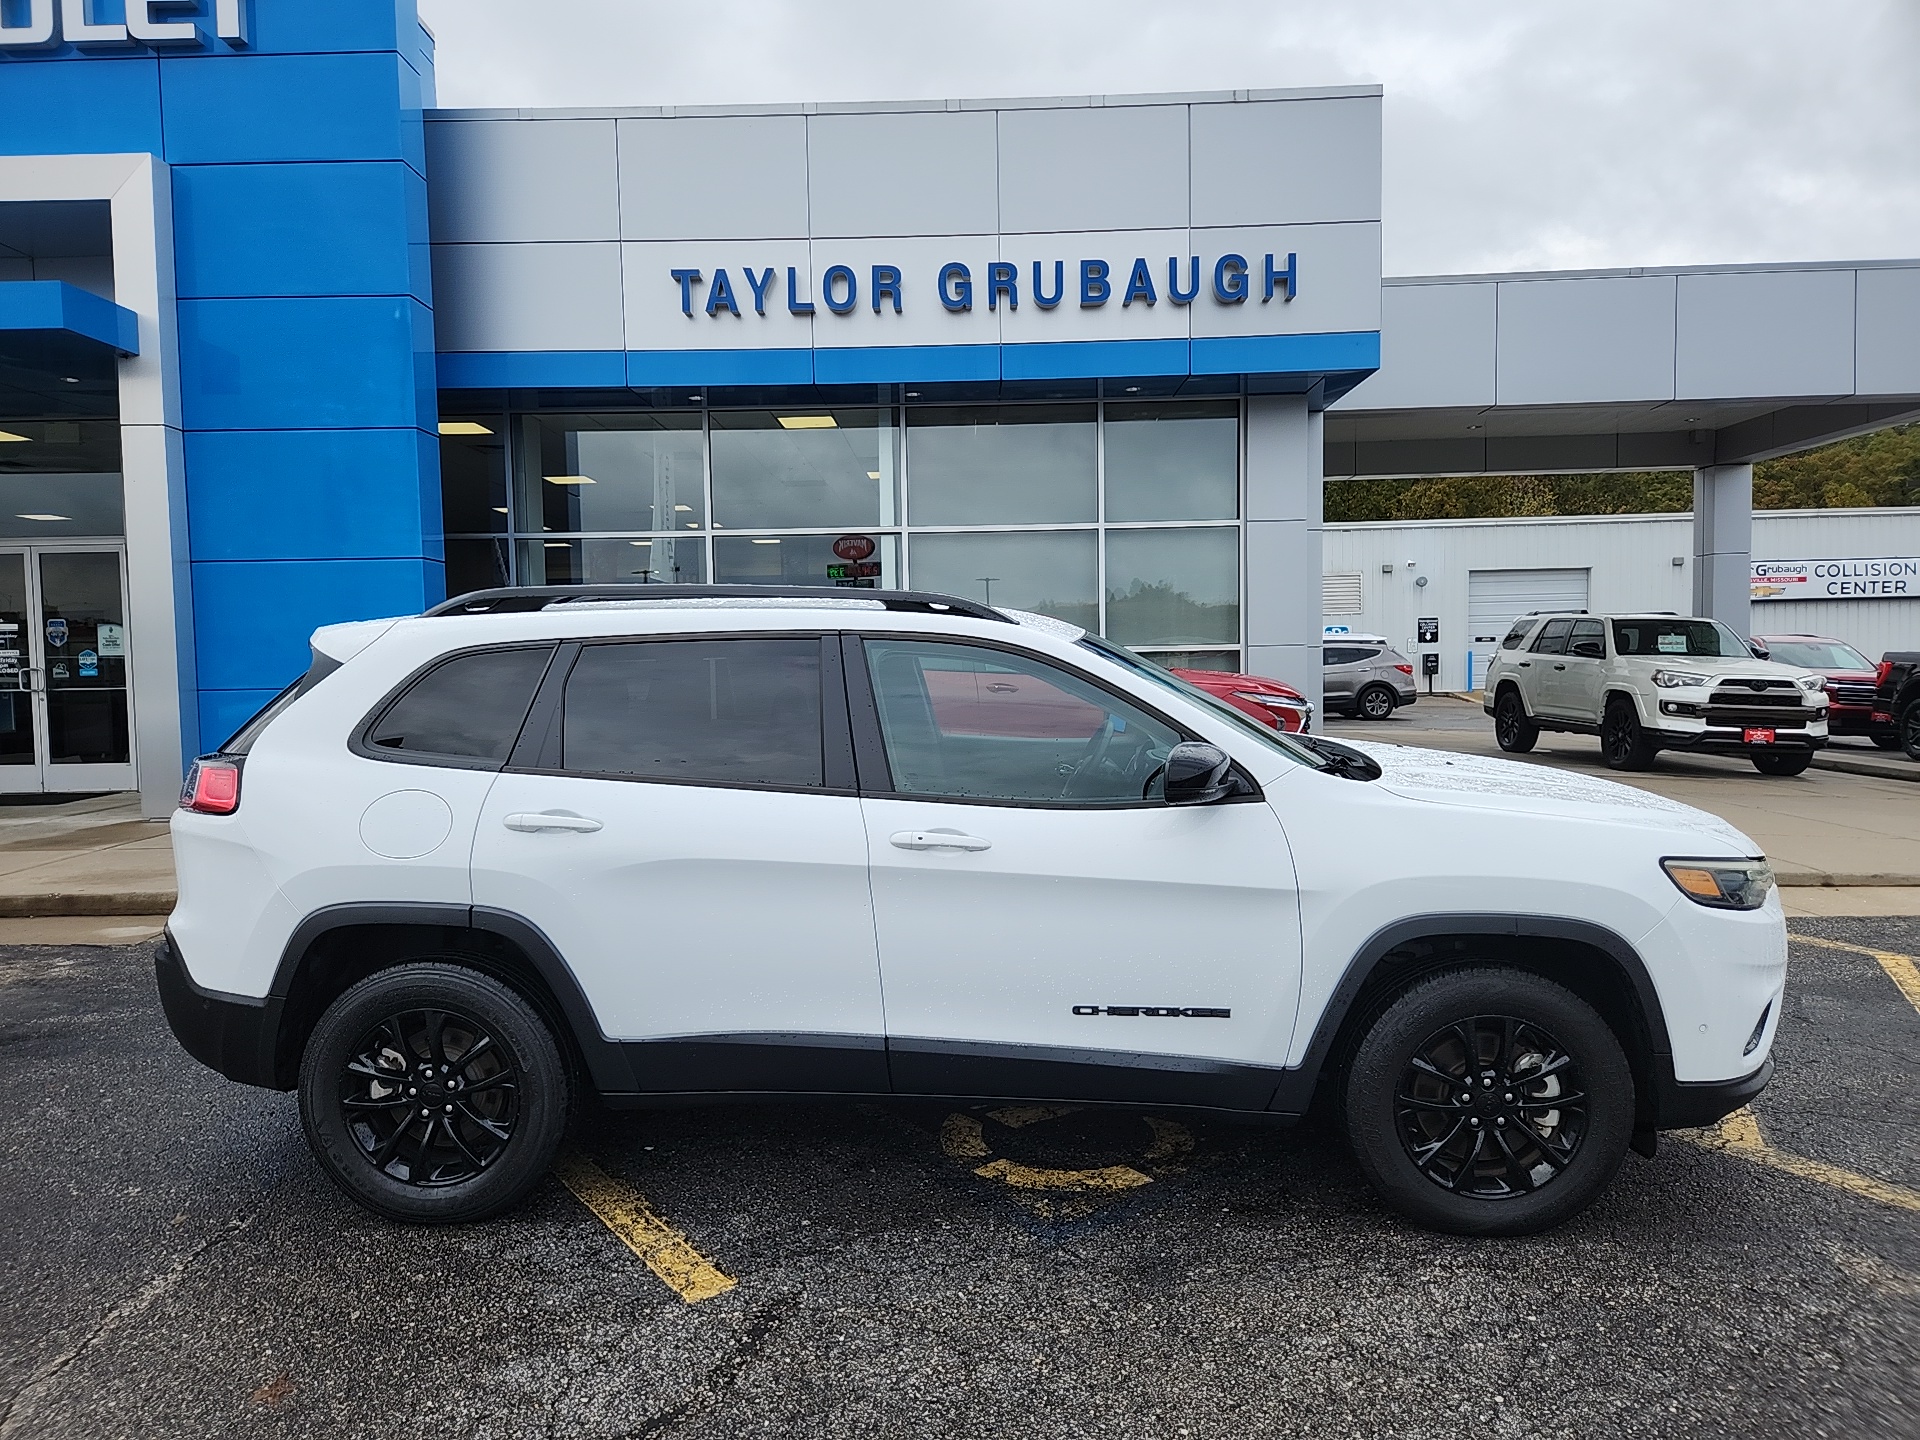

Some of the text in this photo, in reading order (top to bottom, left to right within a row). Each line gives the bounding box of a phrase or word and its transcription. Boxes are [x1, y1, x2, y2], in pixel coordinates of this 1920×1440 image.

[671, 252, 1298, 317] TAYLOR GRUBAUGH
[1756, 564, 1808, 576] Grubaugh
[1814, 562, 1917, 578] COLLISION
[1827, 581, 1907, 596] CENTER
[1072, 1005, 1231, 1019] CHEROKEE
